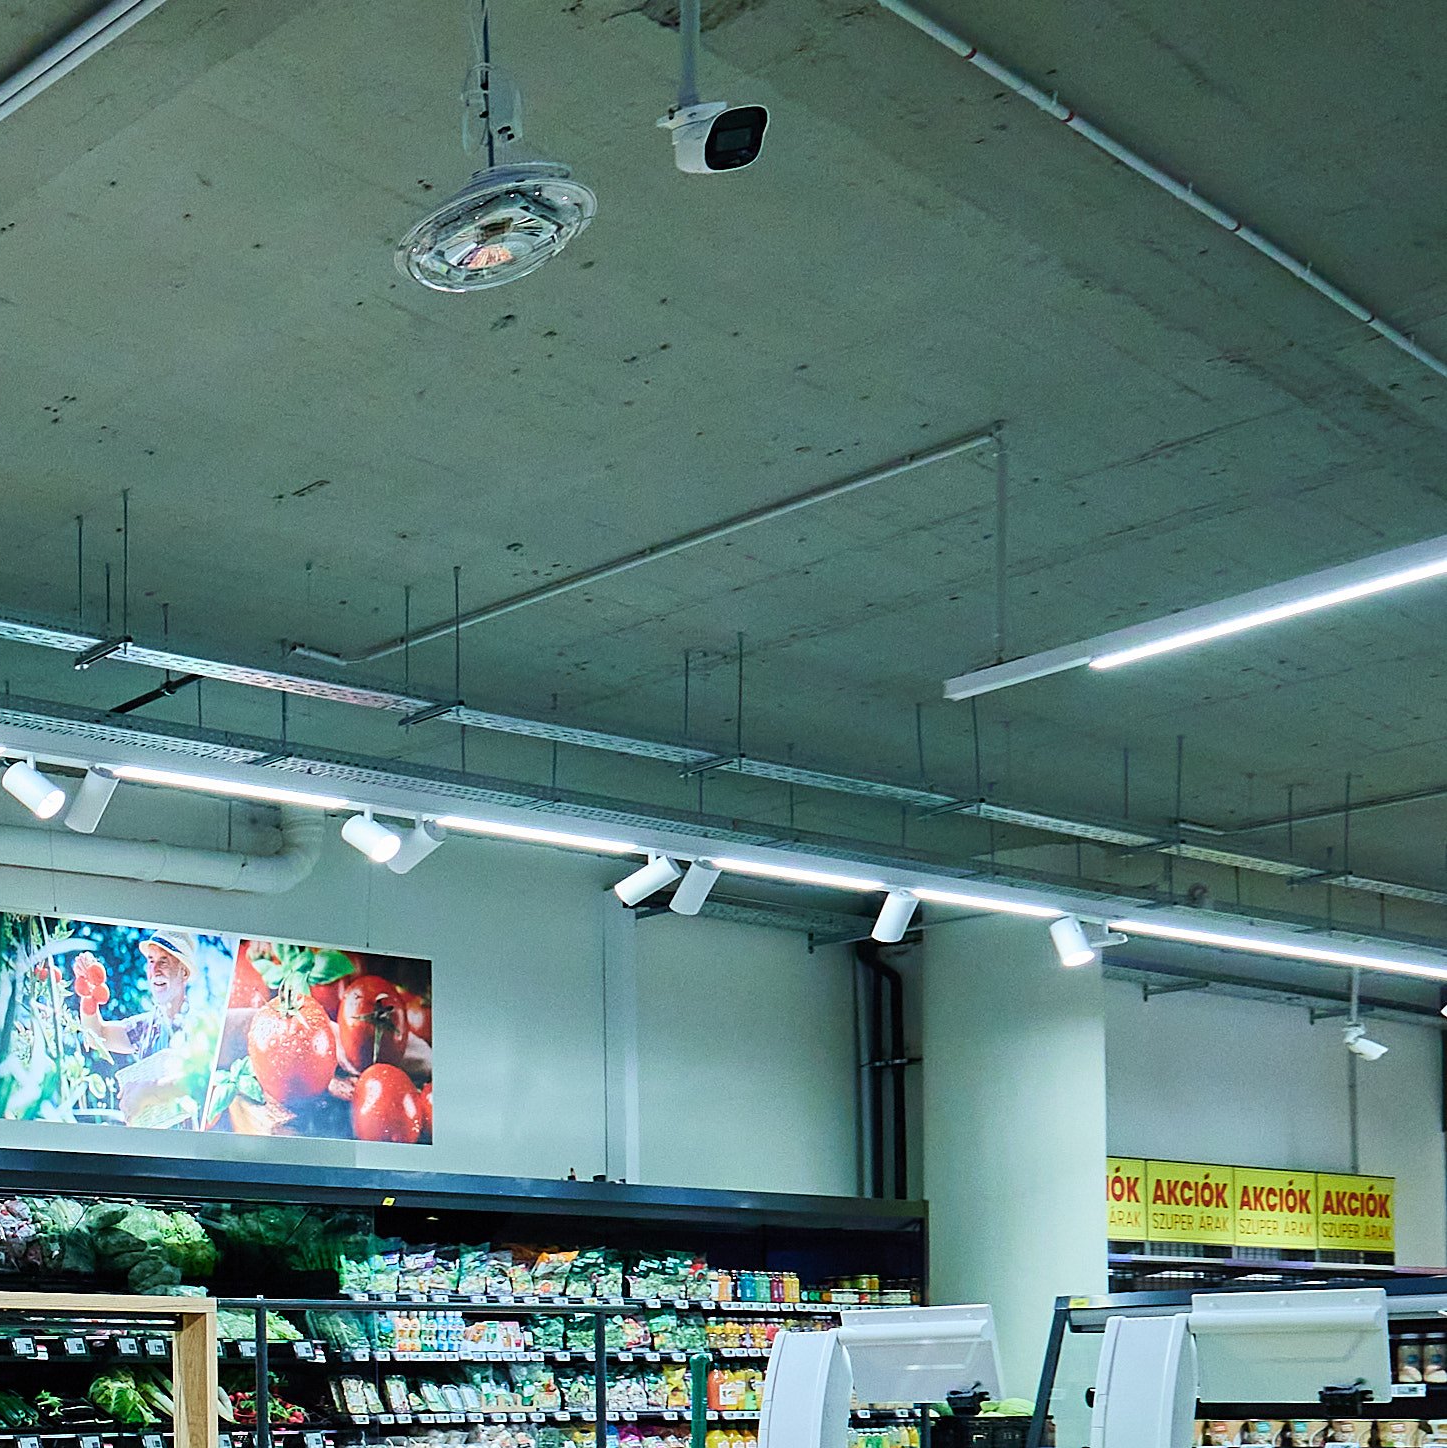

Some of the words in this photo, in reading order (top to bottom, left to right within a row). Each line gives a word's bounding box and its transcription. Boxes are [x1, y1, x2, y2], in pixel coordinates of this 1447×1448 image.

[1152, 1173, 1228, 1208] AKCIÓK
[1239, 1180, 1311, 1214] AKCIÓK
[1322, 1185, 1390, 1218] AKCIÓK
[1152, 1212, 1195, 1231] SZUPER
[1199, 1210, 1229, 1233] ÁRAK
[1239, 1218, 1280, 1237] SZUPER
[1283, 1217, 1312, 1237] ÁRAK
[1322, 1223, 1360, 1239] SZUPER
[1364, 1220, 1391, 1240] ÁRAK
